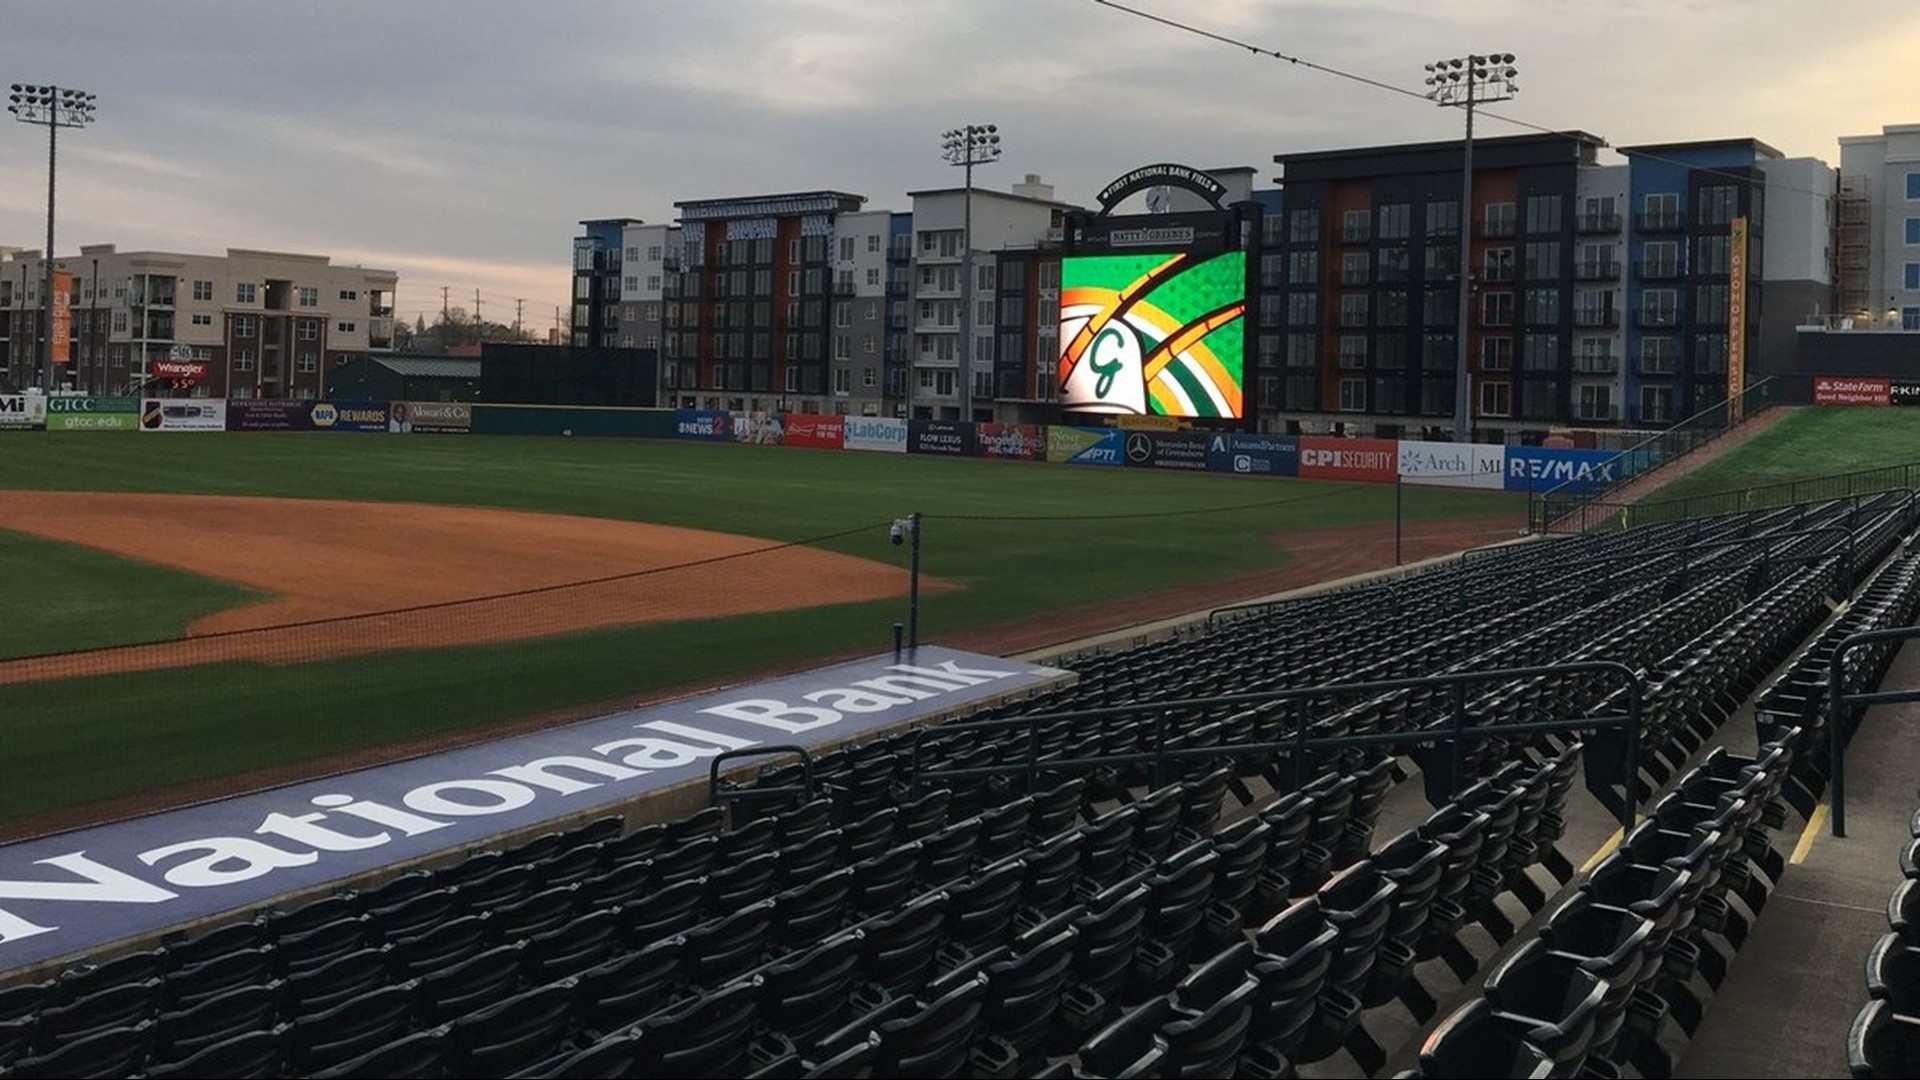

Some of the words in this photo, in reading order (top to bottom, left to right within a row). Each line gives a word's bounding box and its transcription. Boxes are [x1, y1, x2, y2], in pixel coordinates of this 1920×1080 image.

[1108, 177, 1129, 195] FIRST
[1129, 166, 1167, 183] NATIONAL
[1168, 166, 1191, 180] BANK
[1190, 172, 1212, 189] FIELD
[157, 362, 203, 377] Wrangler
[50, 398, 95, 411] GTCC
[64, 415, 122, 429] gtcc.edu
[340, 410, 385, 423] REWARDS
[686, 422, 713, 435] NEWS
[713, 416, 725, 435] 2
[853, 421, 906, 442] LabCorp
[1091, 448, 1116, 460] PTI
[1301, 448, 1342, 467] CPI
[1342, 450, 1393, 470] SECURITY
[1425, 453, 1466, 472] Arch
[1509, 457, 1614, 482] RE/MAX
[0, 720, 764, 945] National
[695, 660, 1022, 735] Bank
